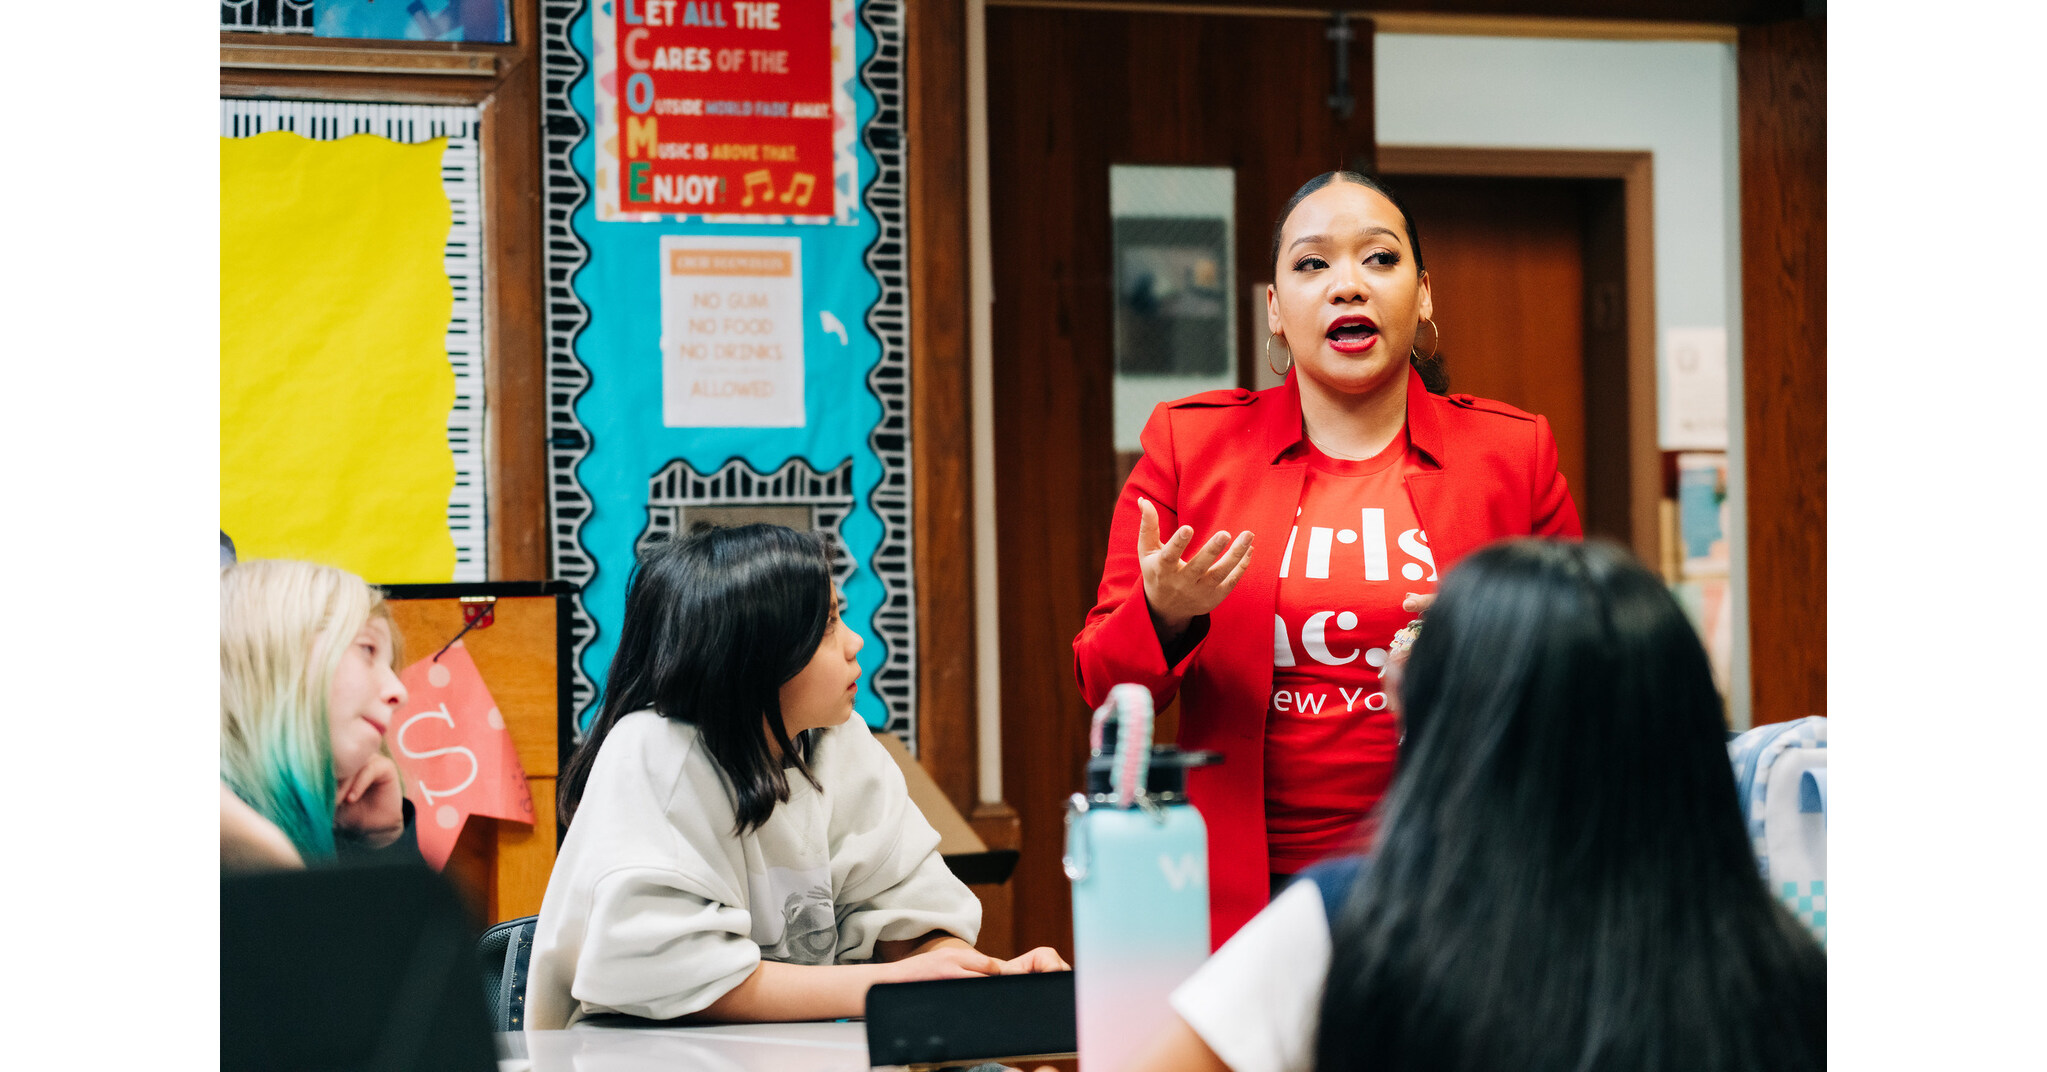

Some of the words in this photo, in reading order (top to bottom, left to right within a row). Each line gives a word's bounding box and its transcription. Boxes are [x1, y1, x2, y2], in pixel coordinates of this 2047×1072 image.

[625, 0, 677, 26] LET
[683, 1, 727, 27] ALL
[733, 2, 780, 30] THE
[624, 28, 711, 71] CARES
[717, 49, 745, 71] OF
[749, 50, 789, 74] THE
[626, 72, 702, 115] OUTSIDE
[626, 116, 692, 159] MUSIC
[693, 143, 709, 160] IS
[711, 144, 759, 161] ABOVE
[629, 162, 727, 205] ENJOY!
[692, 293, 721, 309] NO
[728, 293, 769, 309] GUM
[688, 318, 716, 335] NO
[723, 318, 774, 335] FOOD
[680, 344, 708, 361] NO
[691, 381, 774, 398] ALLOWED
[1269, 685, 1327, 715] ew
[1338, 687, 1388, 712] Yo
